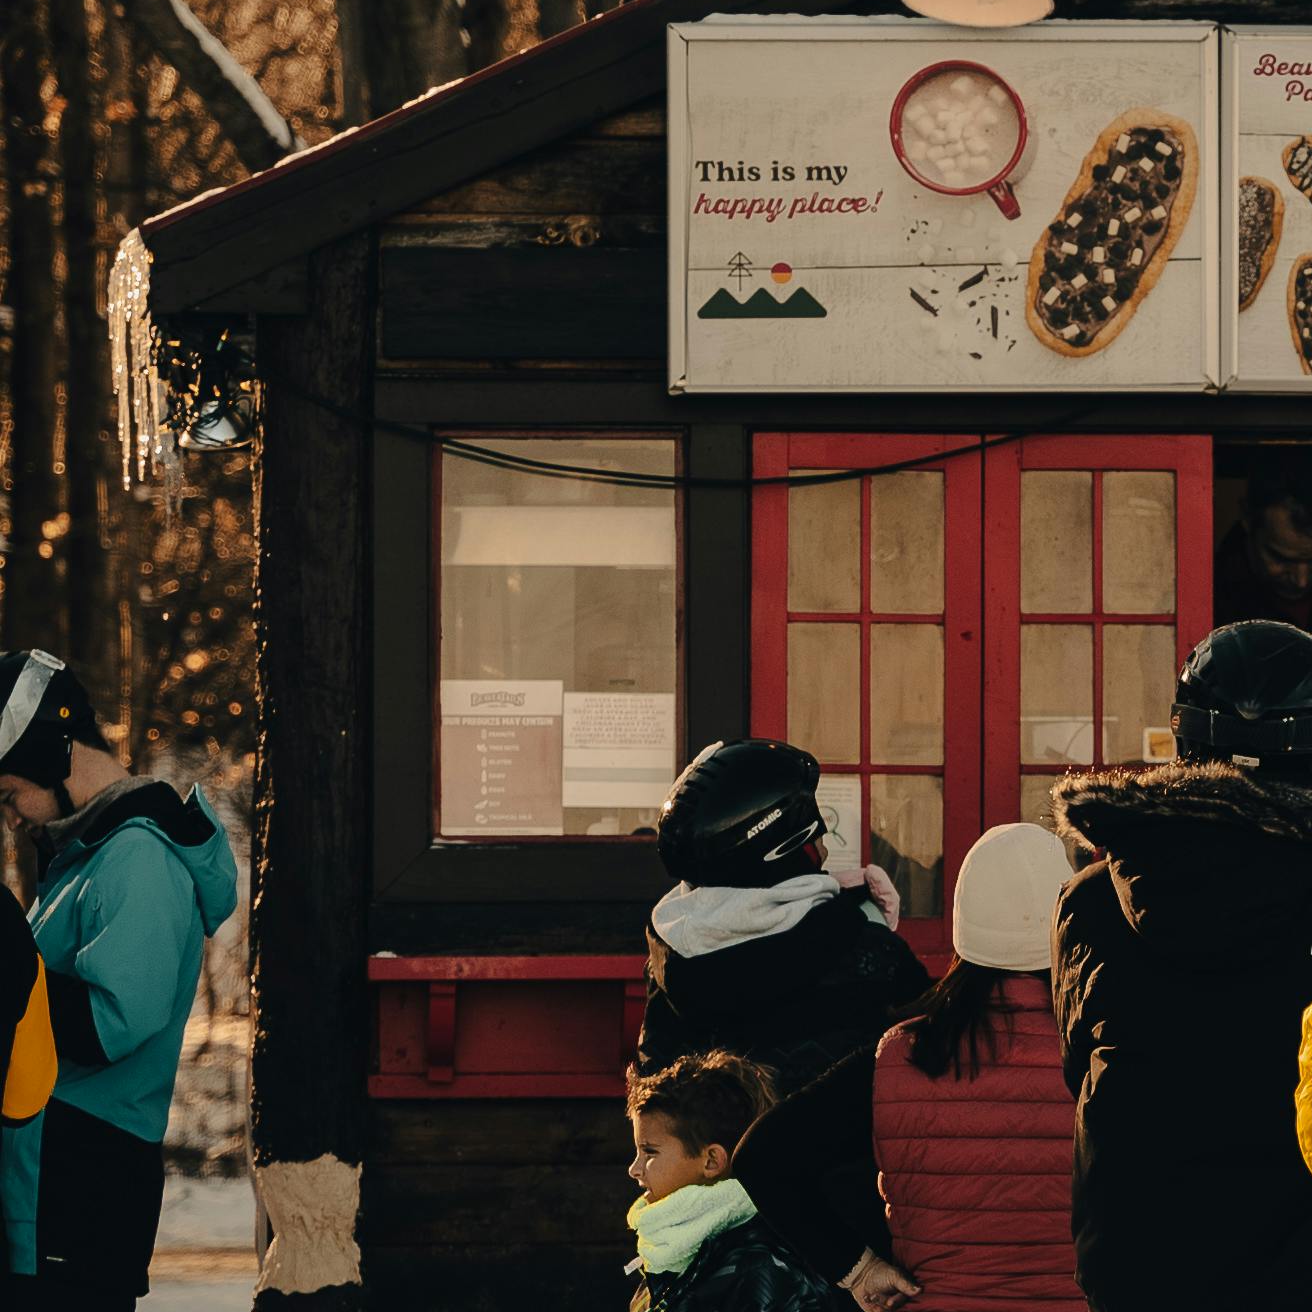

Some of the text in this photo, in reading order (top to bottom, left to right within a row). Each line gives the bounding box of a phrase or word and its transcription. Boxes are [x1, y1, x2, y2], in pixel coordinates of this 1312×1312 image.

[695, 160, 848, 188] This is my
[694, 190, 884, 223] happy place!
[746, 808, 783, 839] ATOMIC
